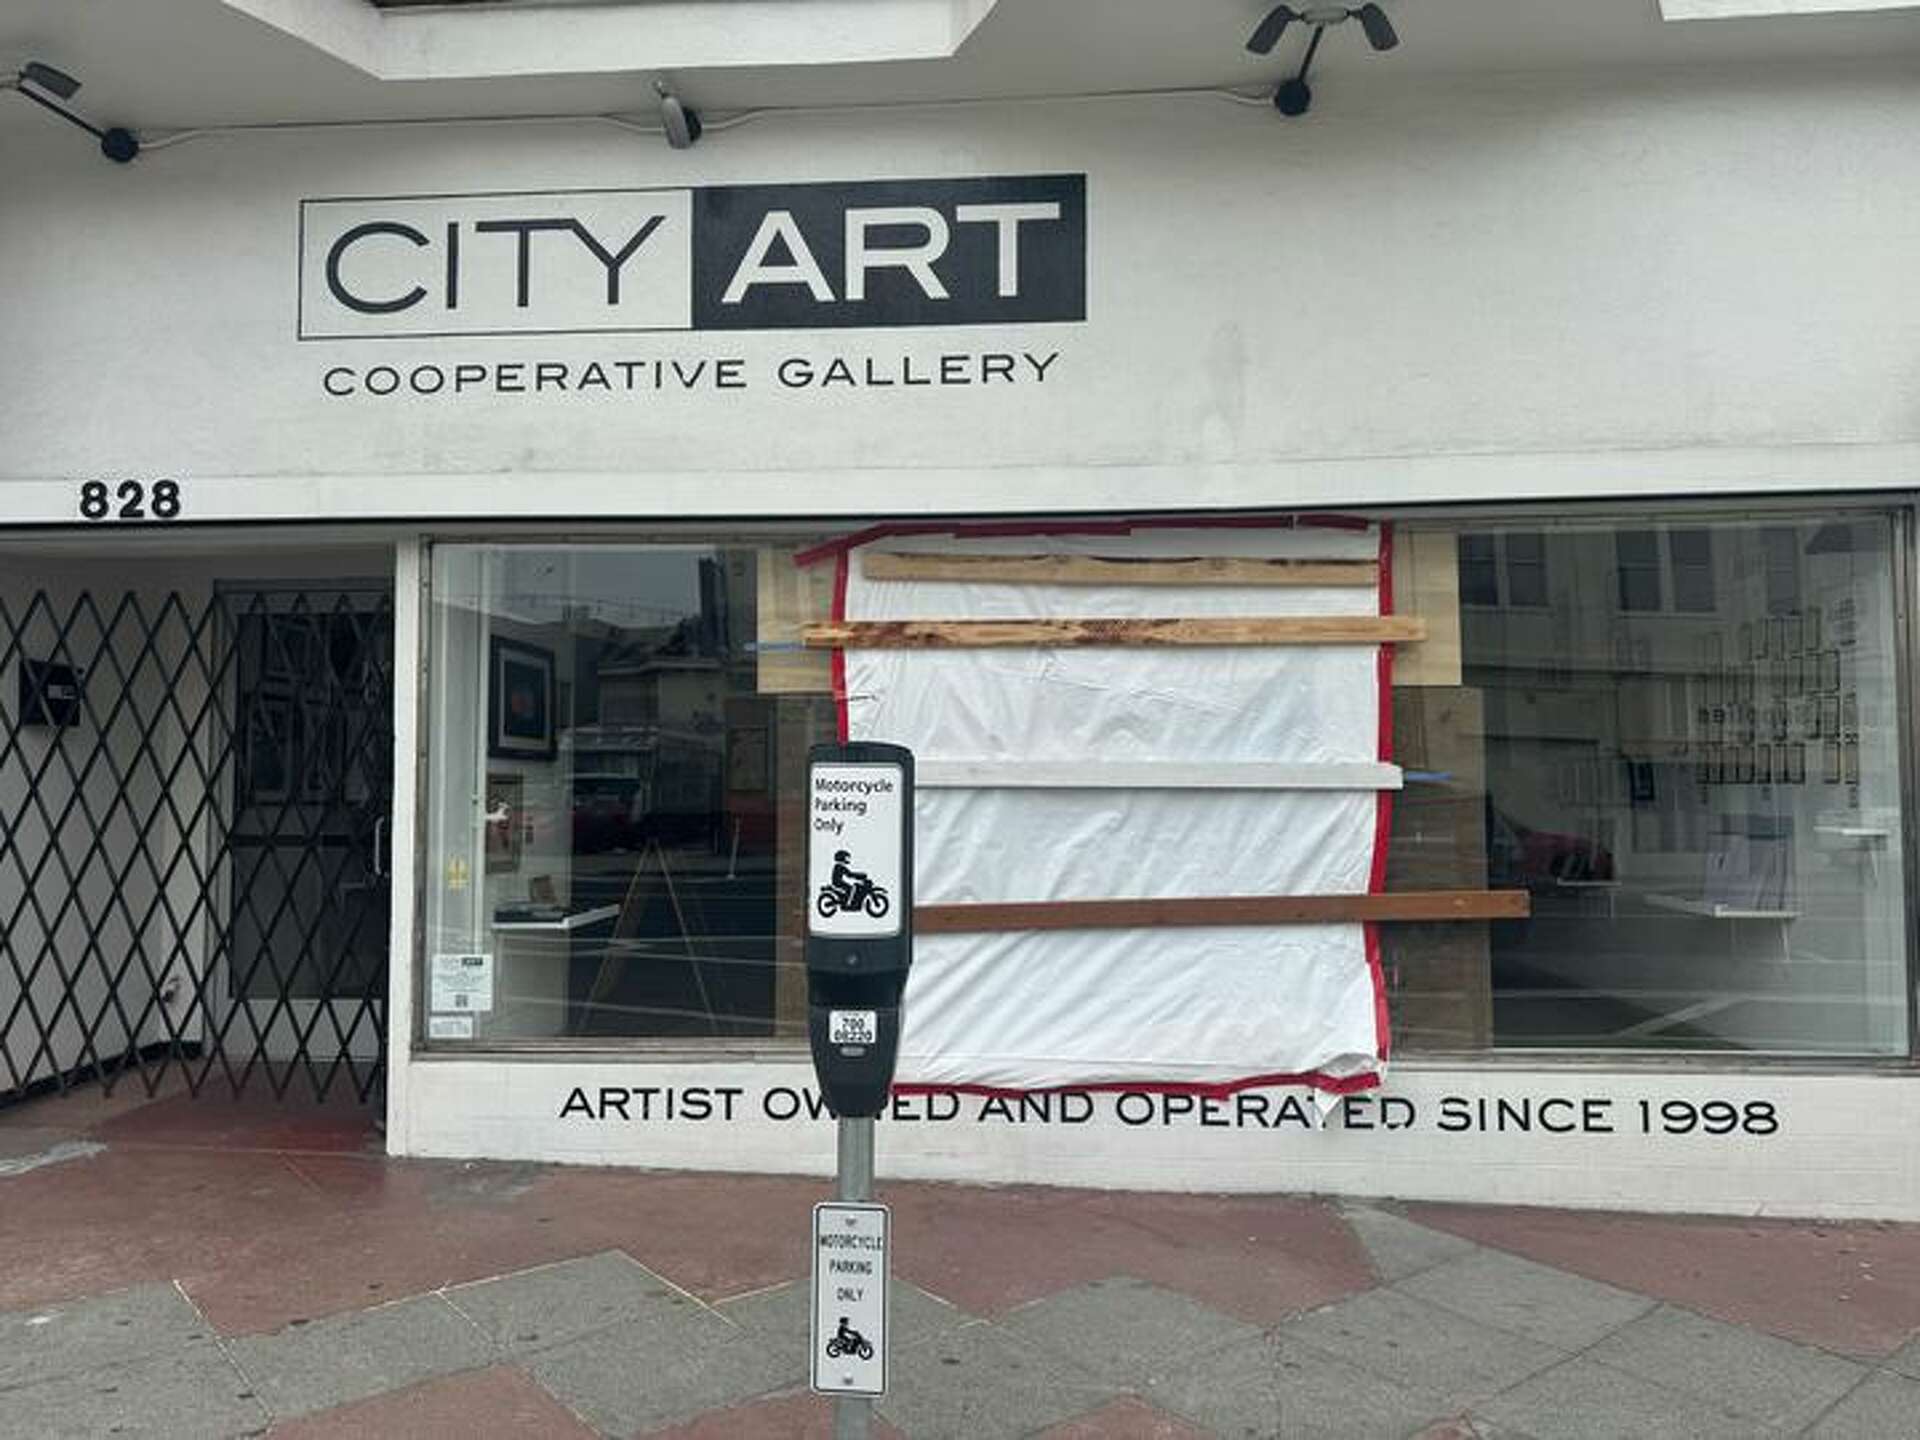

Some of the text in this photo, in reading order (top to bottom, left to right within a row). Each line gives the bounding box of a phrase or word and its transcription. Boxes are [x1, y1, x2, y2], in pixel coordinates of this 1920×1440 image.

[325, 202, 1060, 315] CITY ART
[323, 352, 1059, 396] COOPERATIVE GALLERY
[79, 479, 181, 519] 828
[815, 778, 893, 796] Motorcycle
[815, 797, 867, 816] Parking
[814, 818, 844, 836] Only
[559, 1087, 1779, 1136] ARTIST OWED AND OPERAED SINCE 1998
[820, 1234, 882, 1250] MOTORCYCLE
[829, 1259, 872, 1275] PARKING
[836, 1287, 863, 1301] ONLY
